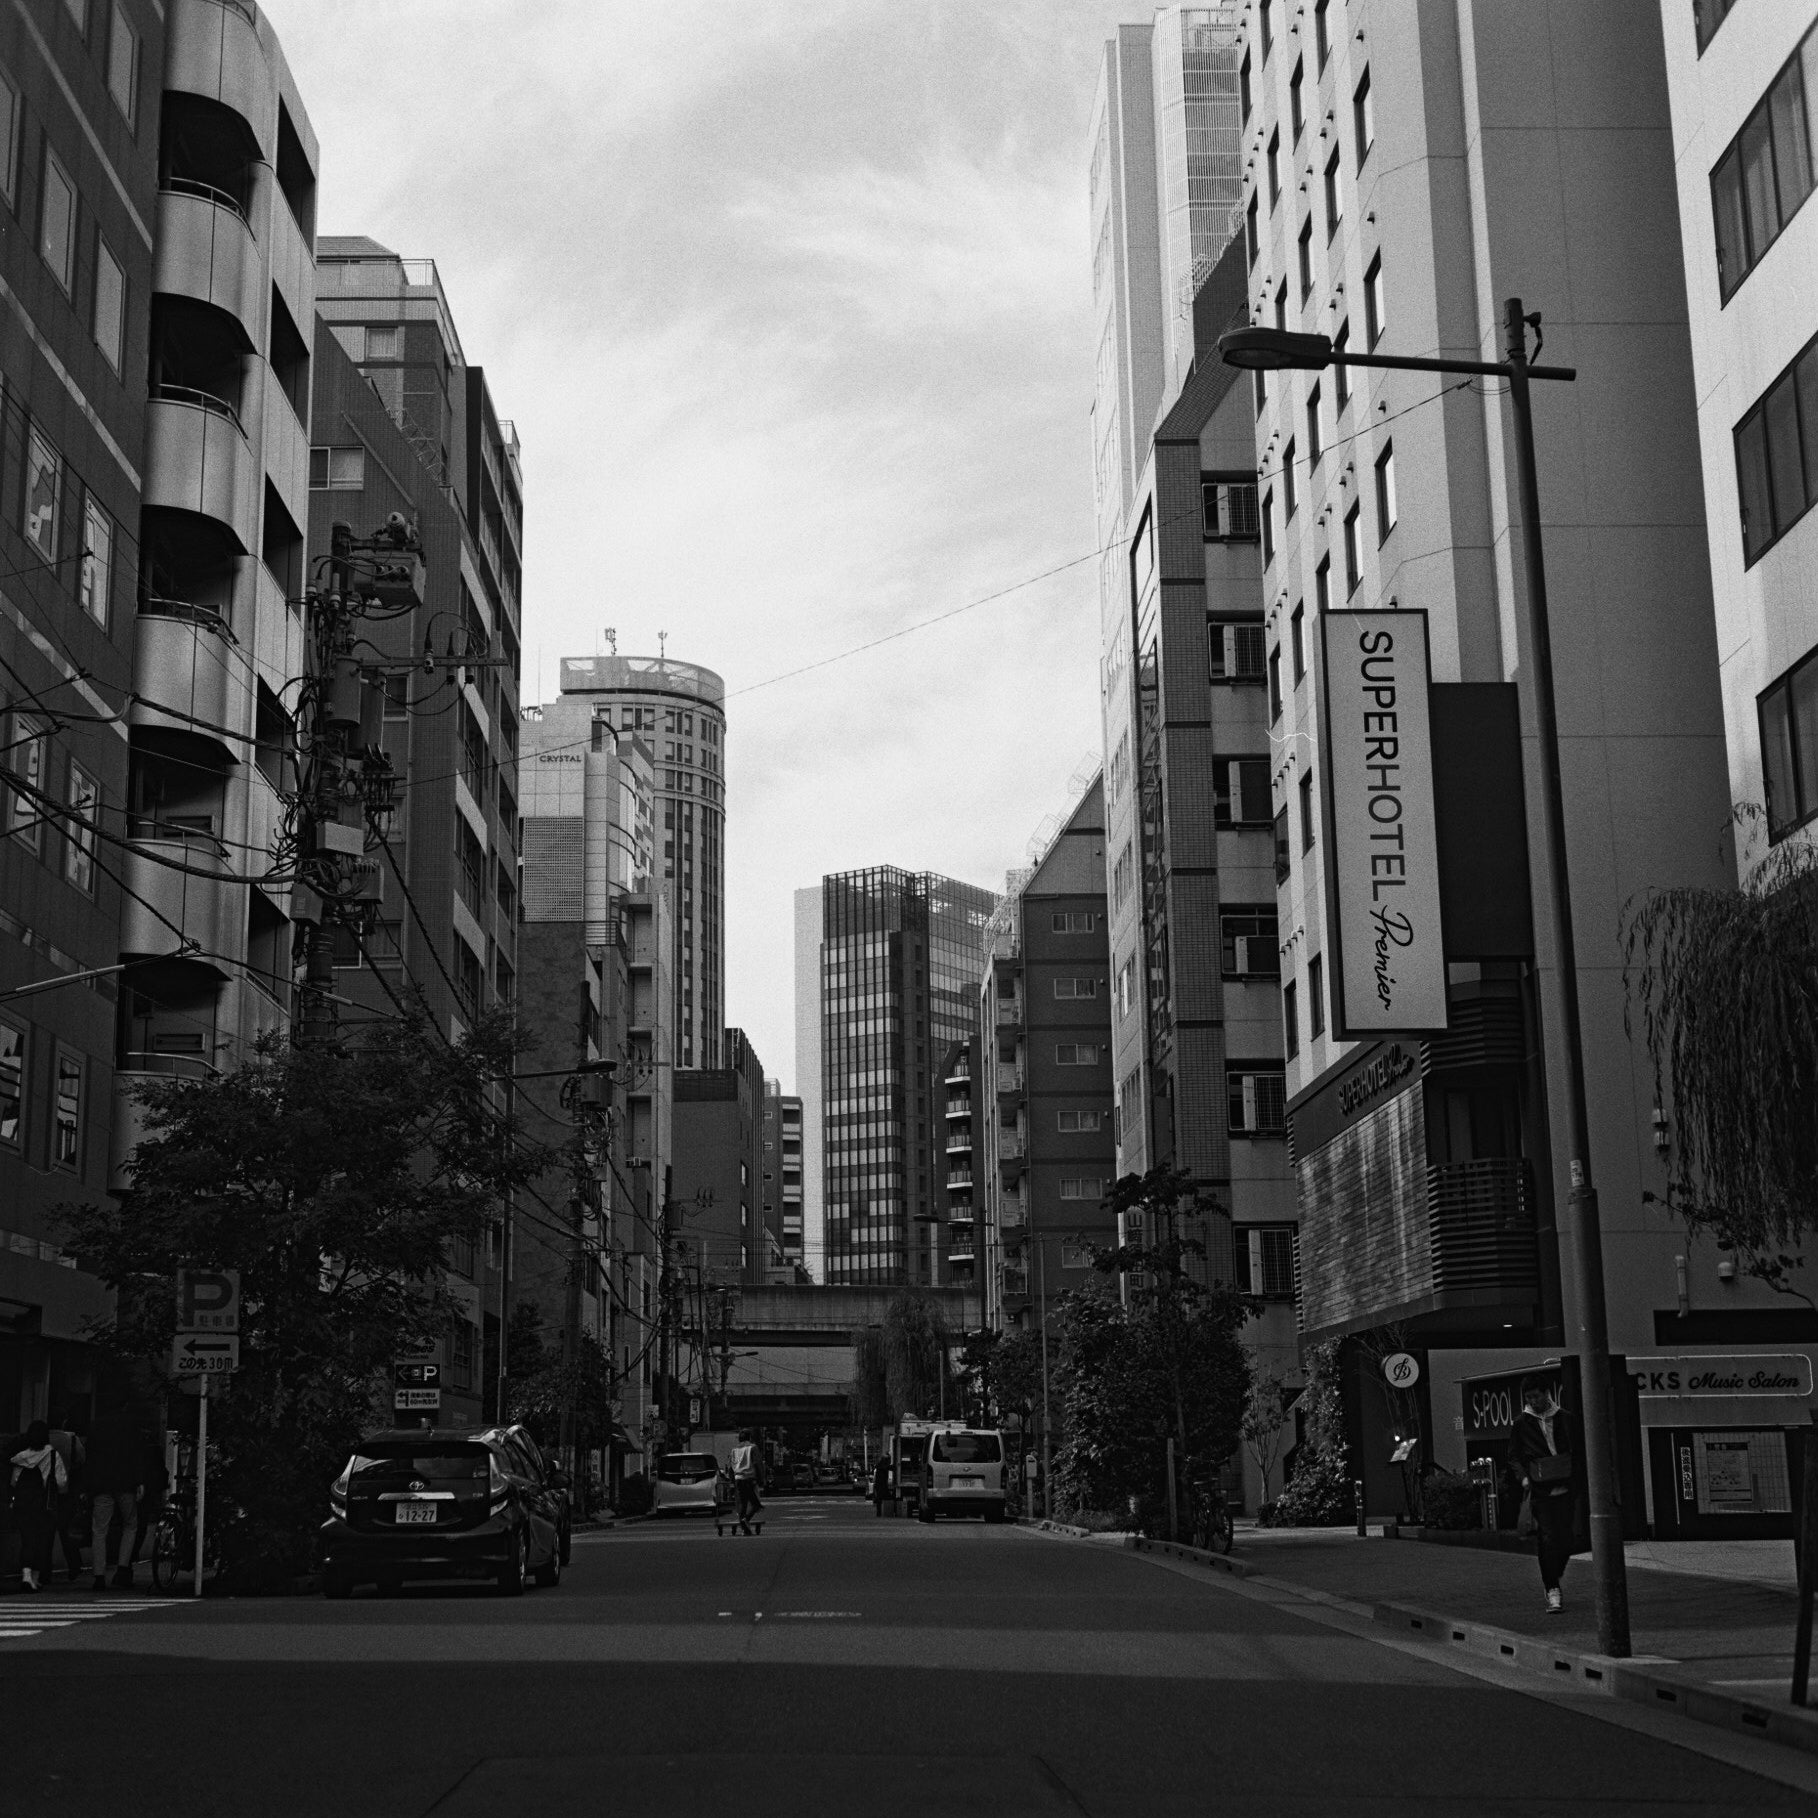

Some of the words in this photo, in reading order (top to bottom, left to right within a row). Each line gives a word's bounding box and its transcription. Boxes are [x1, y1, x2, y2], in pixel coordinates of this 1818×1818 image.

[539, 755, 582, 763] CRYSTAL
[1359, 630, 1406, 902] SUPERHOTEL
[1369, 904, 1413, 1012] Premier
[183, 1271, 233, 1327] P
[423, 1365, 438, 1381] P
[1688, 1371, 1744, 1390] Music
[1747, 1370, 1801, 1389] Salon
[1472, 1386, 1514, 1429] S-POOL
[406, 1510, 435, 1522] 12-27
